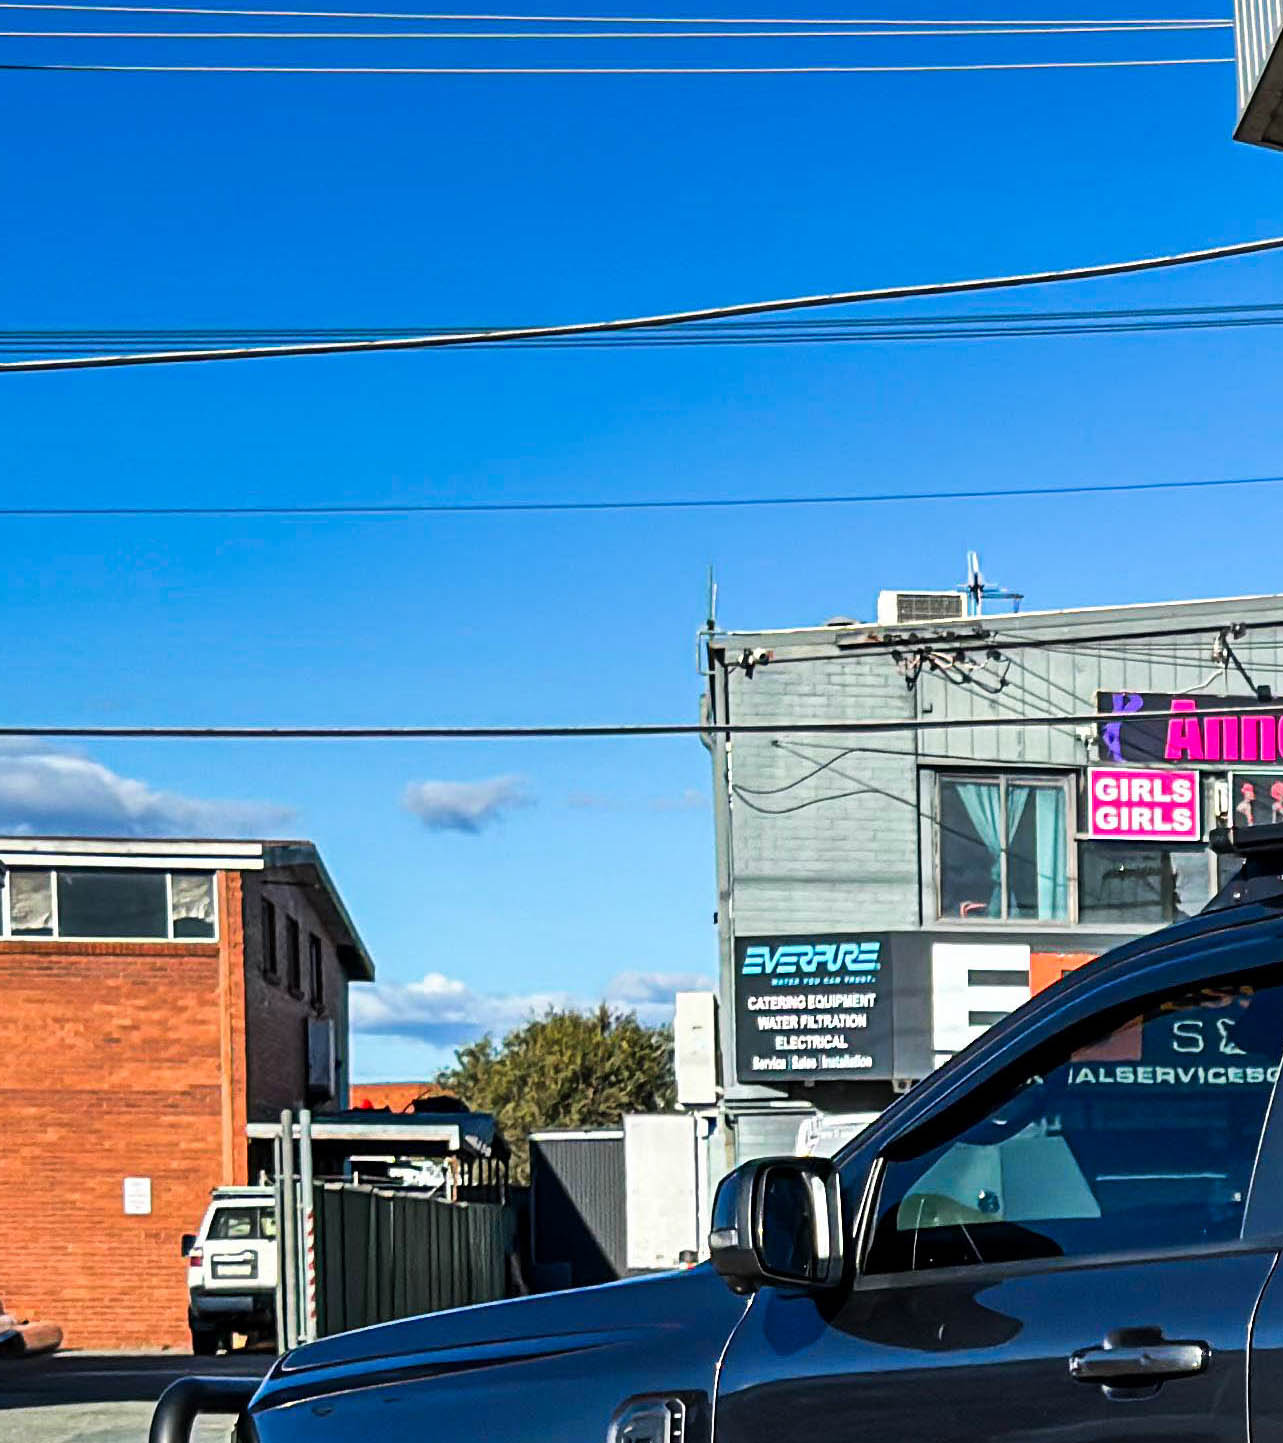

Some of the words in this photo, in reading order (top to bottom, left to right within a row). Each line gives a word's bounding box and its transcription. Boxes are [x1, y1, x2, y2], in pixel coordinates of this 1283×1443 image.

[1095, 778, 1193, 804] GIRLS
[1095, 806, 1193, 832] GIRLS
[742, 942, 880, 975] EVERPURE
[747, 994, 807, 1011] CATERING
[807, 993, 877, 1009] EQUIPMENT
[757, 1015, 798, 1031] WATER
[799, 1013, 867, 1030] FILTRATION
[775, 1034, 849, 1050] ELECTRICAL
[752, 1056, 787, 1070] Service
[821, 1054, 873, 1069] Installation
